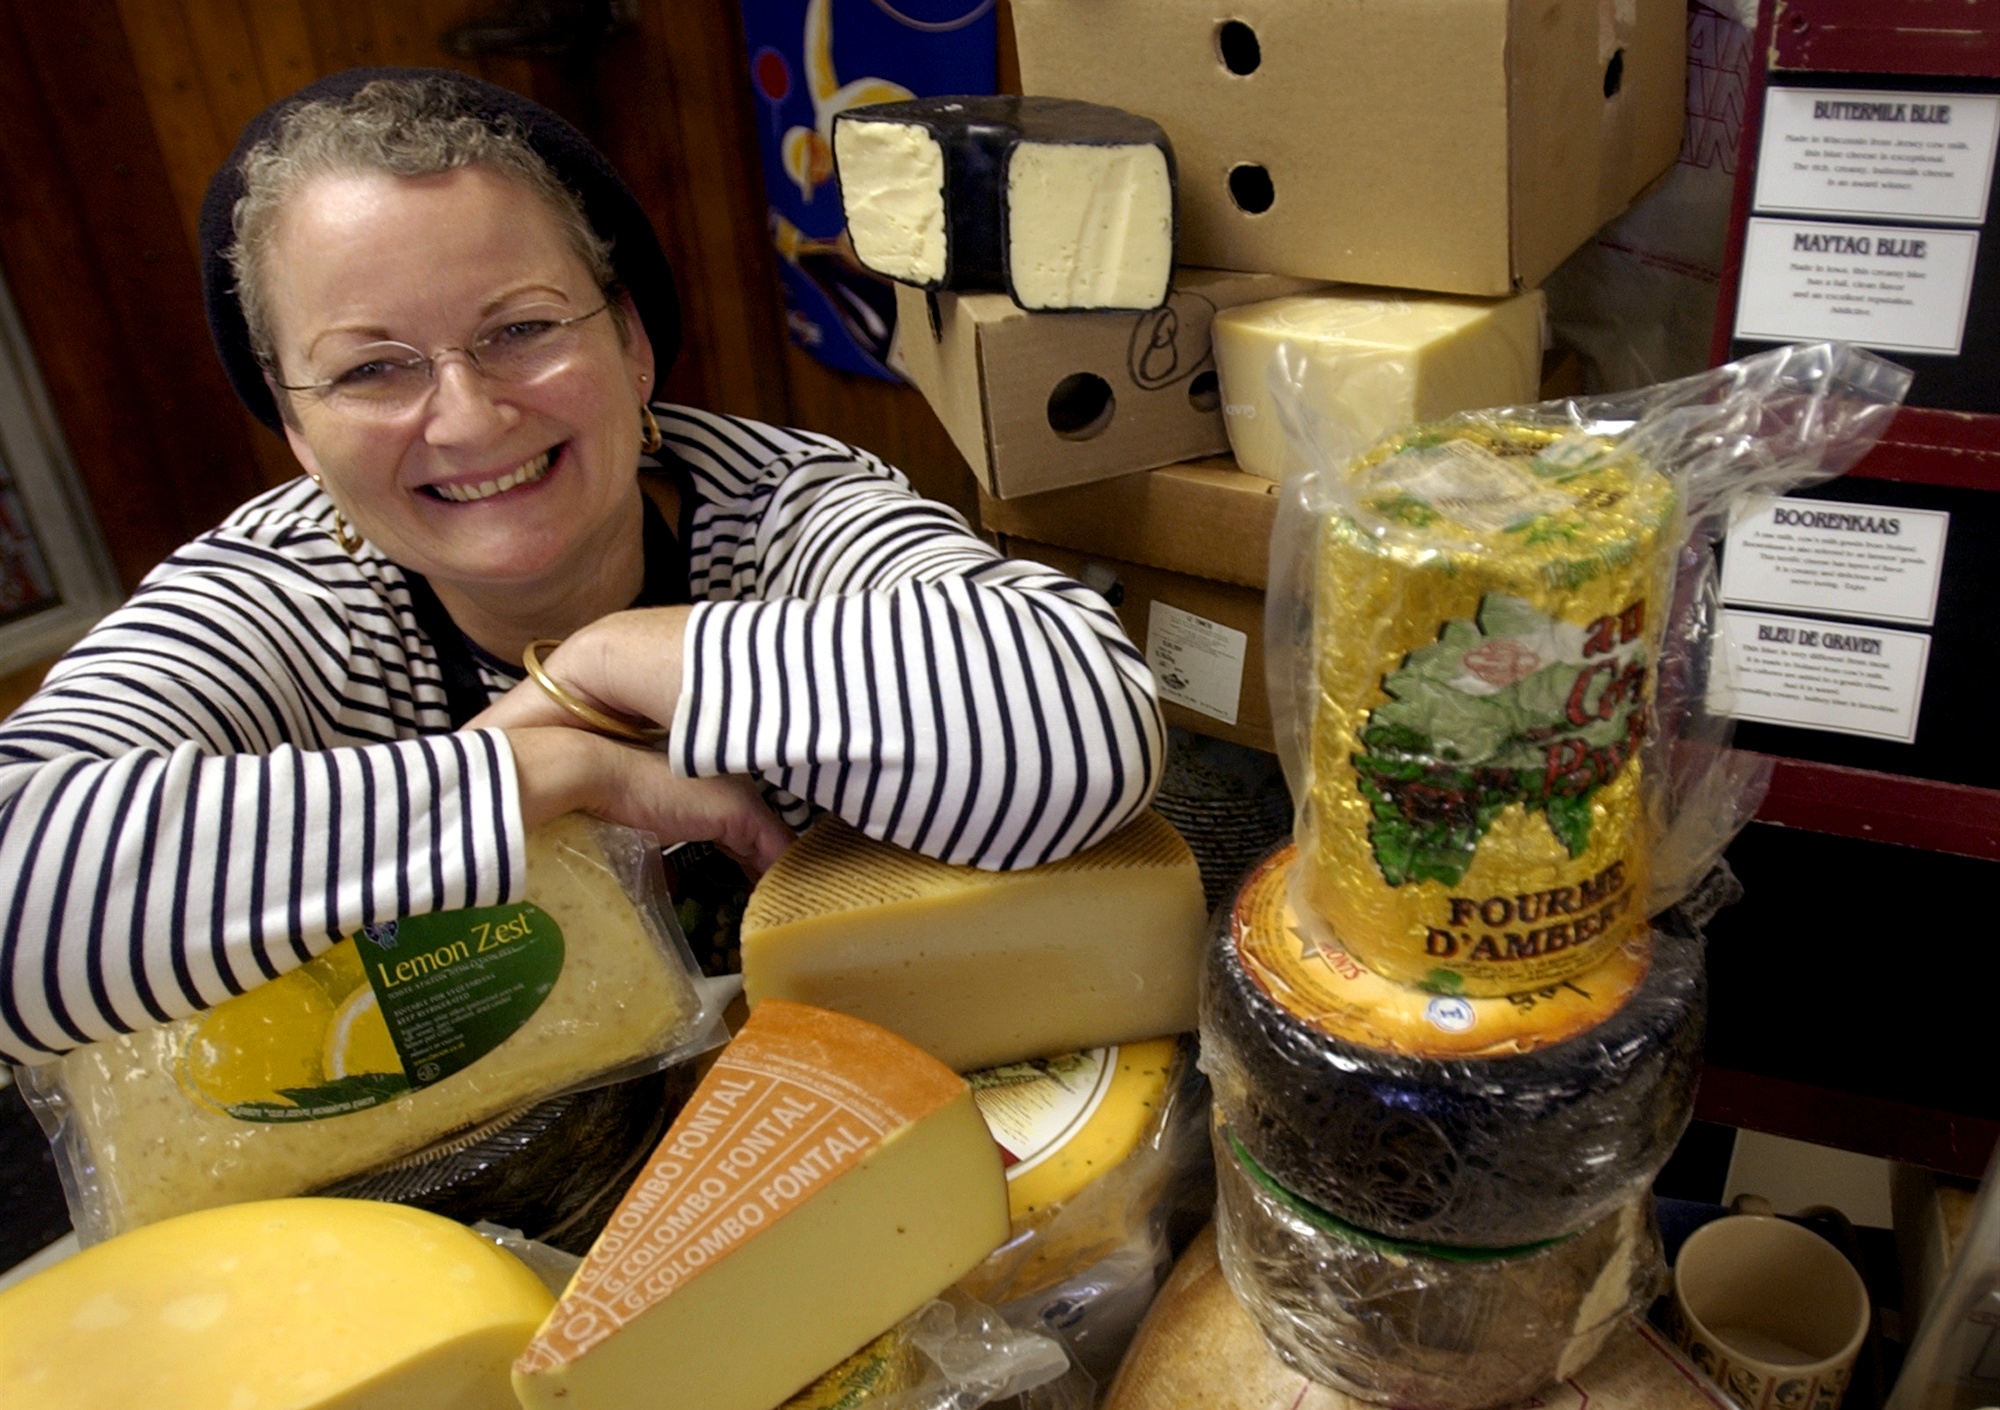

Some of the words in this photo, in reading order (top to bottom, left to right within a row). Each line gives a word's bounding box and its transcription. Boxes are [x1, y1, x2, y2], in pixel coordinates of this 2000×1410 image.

[1814, 100, 1907, 122] BUTTERMILK
[1910, 104, 1950, 124] BLUE
[1793, 233, 1869, 254] MAYTAG
[1876, 238, 1926, 257] BLUE
[1773, 508, 1900, 535] BOORENKAAS
[1758, 625, 1794, 643] BLEU
[1799, 630, 1818, 646] DE
[1822, 633, 1880, 654] GRAVEN
[1447, 859, 1626, 927] FOURME
[377, 939, 470, 988] Lemon
[471, 913, 533, 953] Zest
[579, 1162, 681, 1283] G.COLOMBO
[668, 1077, 755, 1160] FONTAL
[602, 1177, 726, 1294] G.COLOMBO
[717, 1095, 816, 1180] FONTAL
[759, 1126, 870, 1211] FONTAL
